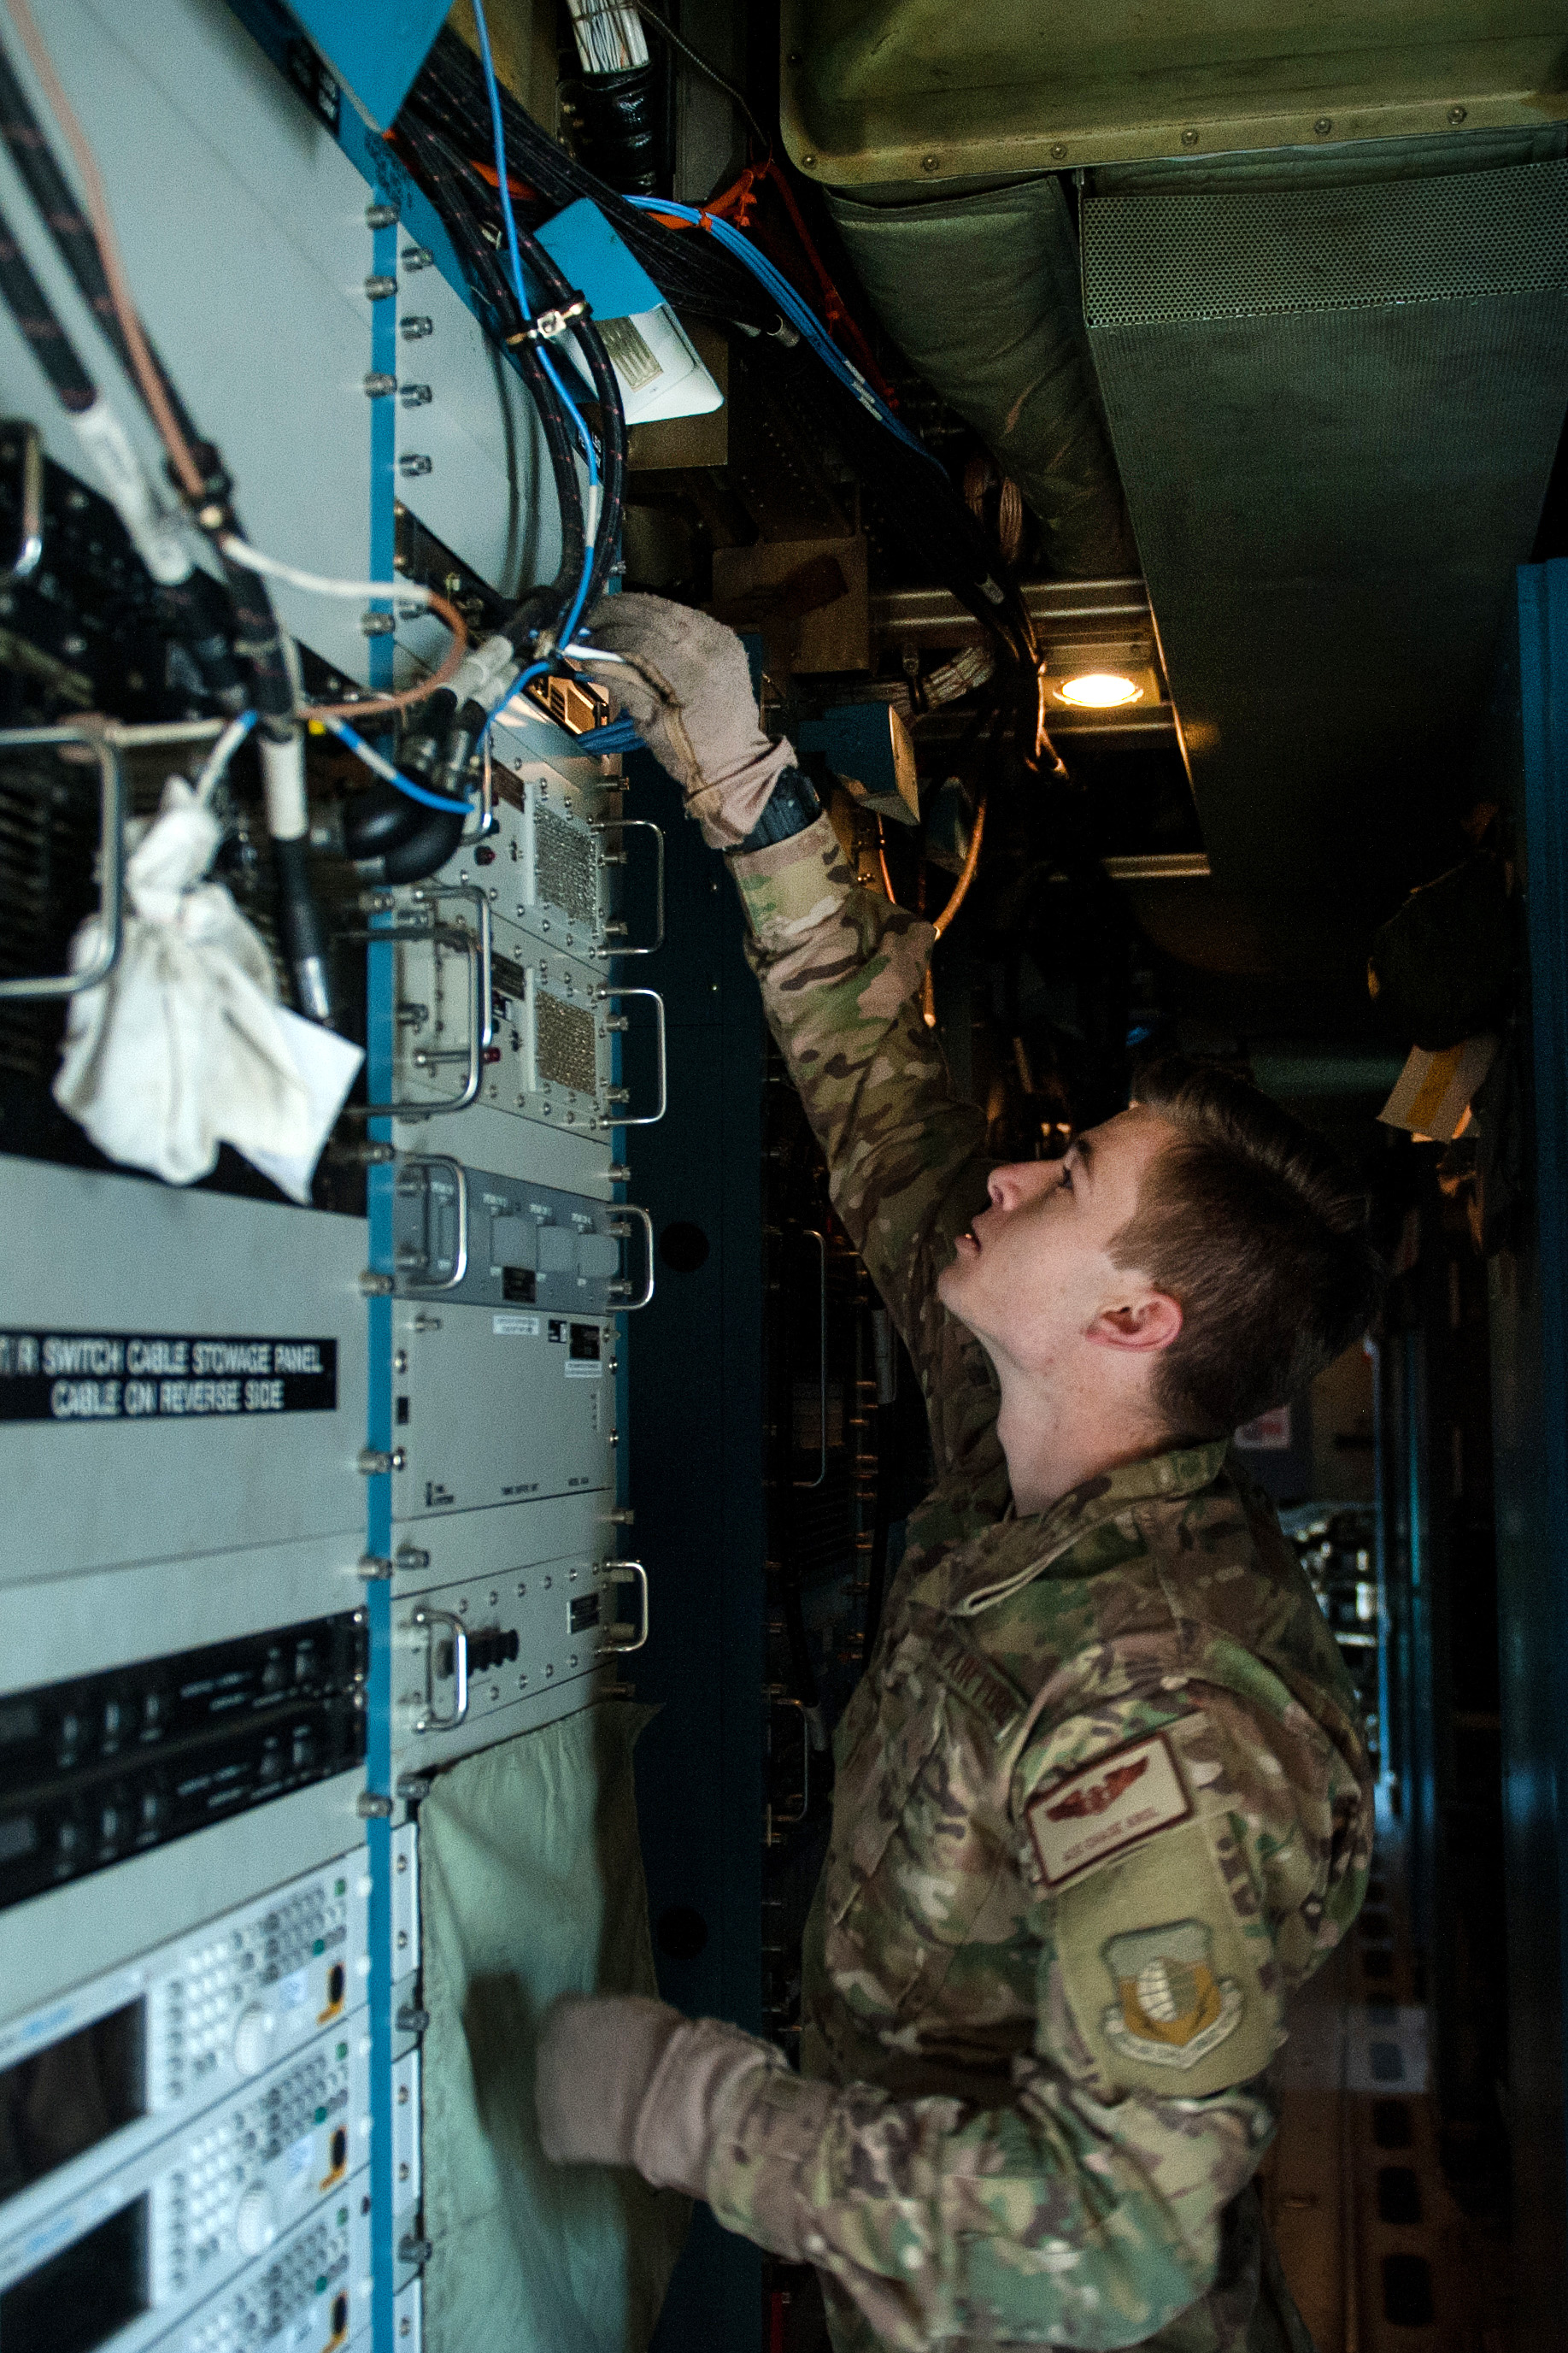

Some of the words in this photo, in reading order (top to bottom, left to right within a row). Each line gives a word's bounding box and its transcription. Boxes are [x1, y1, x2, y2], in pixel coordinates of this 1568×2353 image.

[43, 1337, 125, 1375] SWITCH
[126, 1338, 190, 1375] CABLE
[192, 1342, 273, 1374] STOWAGE
[274, 1344, 323, 1373] PANEL
[51, 1378, 122, 1418] CABLE
[124, 1379, 157, 1415] ON
[160, 1379, 242, 1414] REVERSE
[244, 1379, 285, 1410] SIDE
